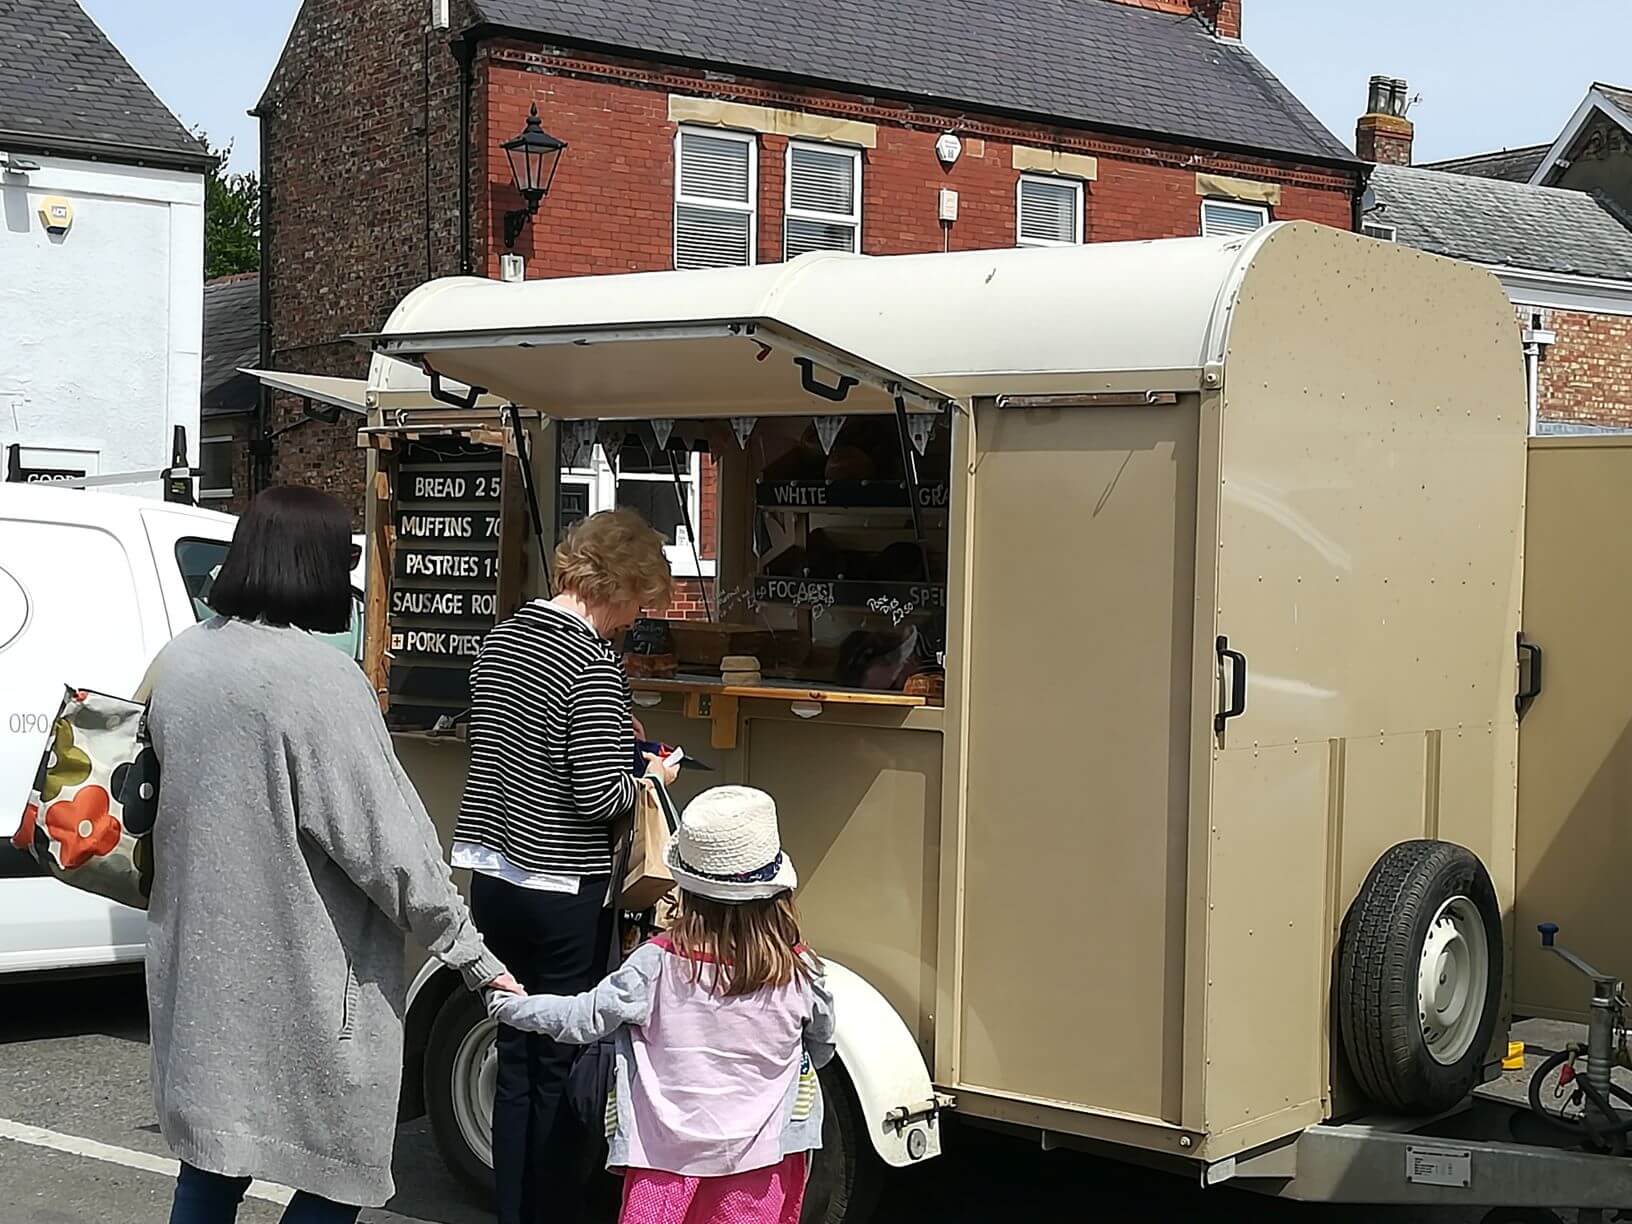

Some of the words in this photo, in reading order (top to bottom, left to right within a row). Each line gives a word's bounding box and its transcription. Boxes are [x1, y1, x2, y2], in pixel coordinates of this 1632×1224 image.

[415, 477, 466, 498] BREAD
[774, 485, 827, 505] WHITE
[401, 515, 472, 537] MUFFINS
[406, 554, 479, 577] PASTRIES
[392, 592, 463, 615] SAUSAGE
[407, 631, 447, 654] PORK
[449, 634, 481, 656] PIES
[9, 712, 49, 734] 0190
